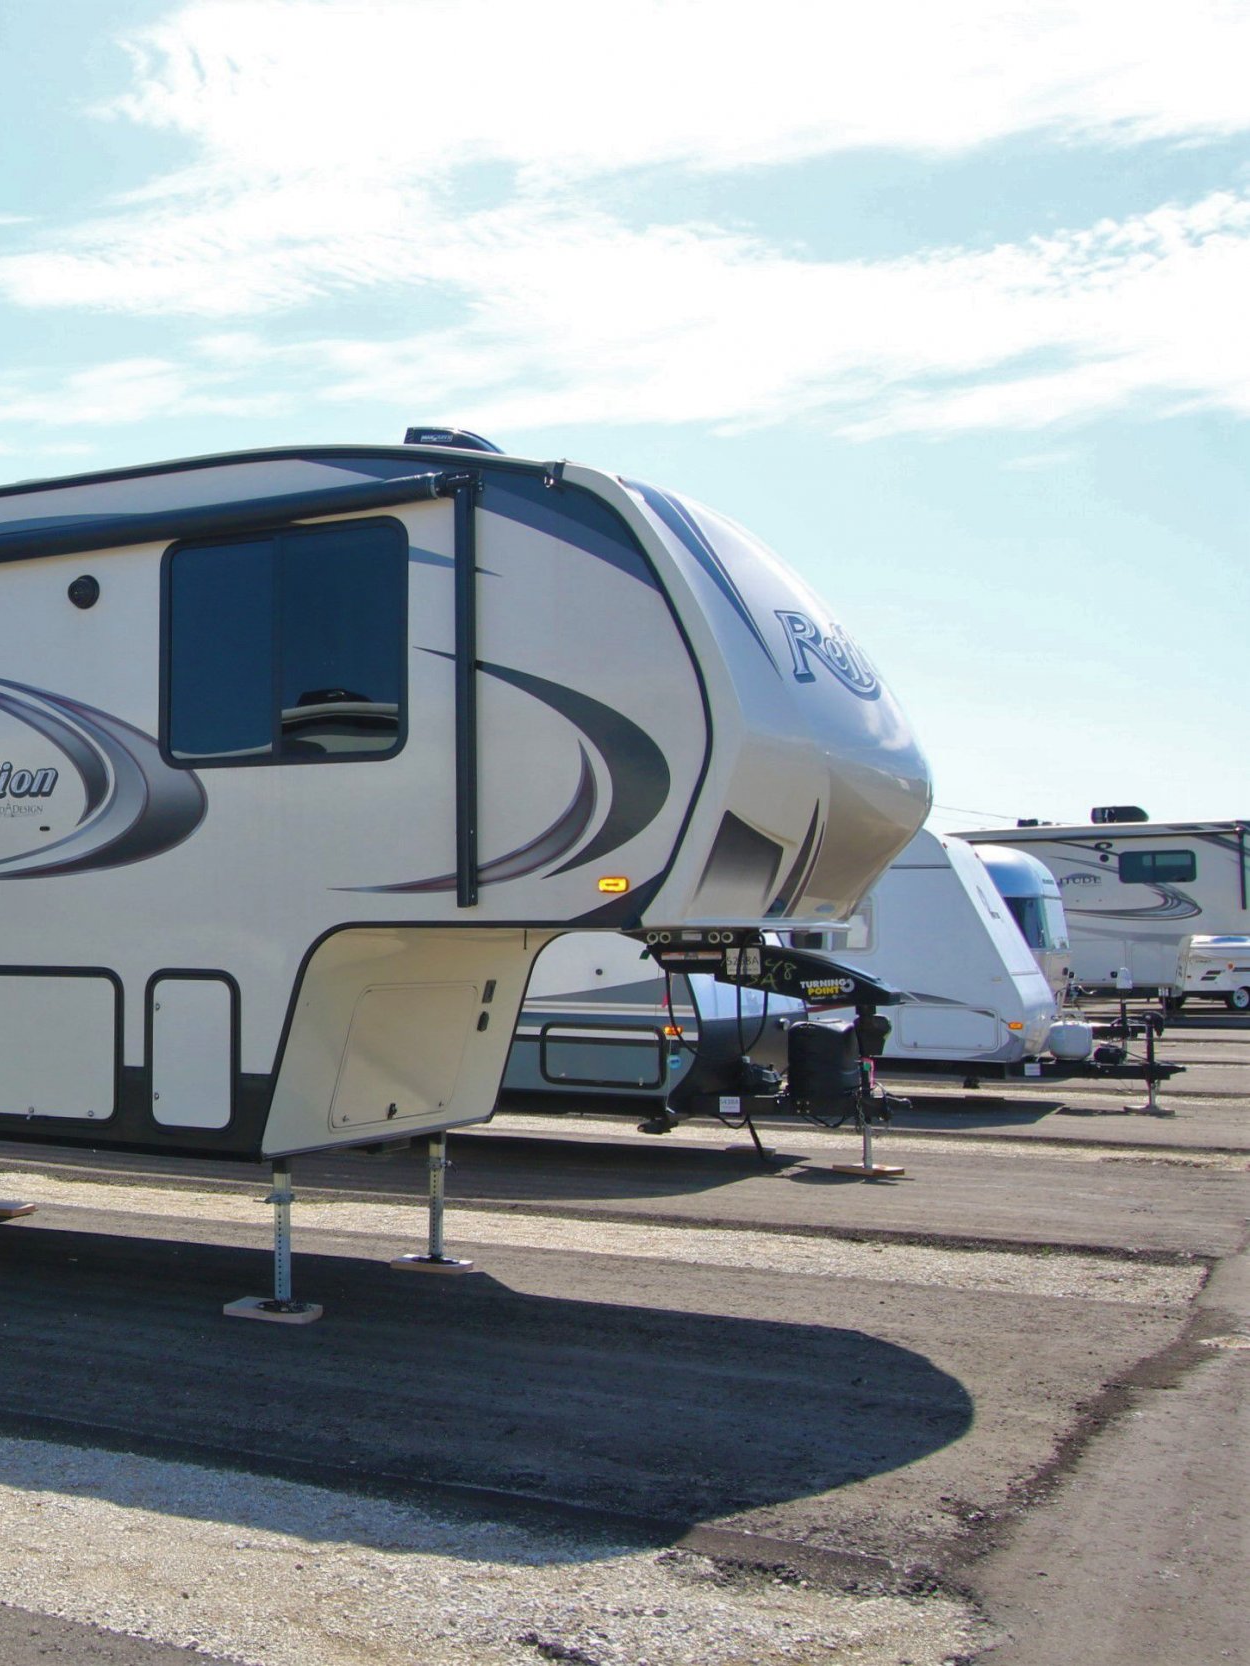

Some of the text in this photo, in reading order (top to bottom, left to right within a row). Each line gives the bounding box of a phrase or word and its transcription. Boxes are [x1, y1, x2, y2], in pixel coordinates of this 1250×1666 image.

[13, 804, 44, 814] DESIGN
[800, 978, 847, 989] TURNING
[807, 986, 840, 996] POINT
